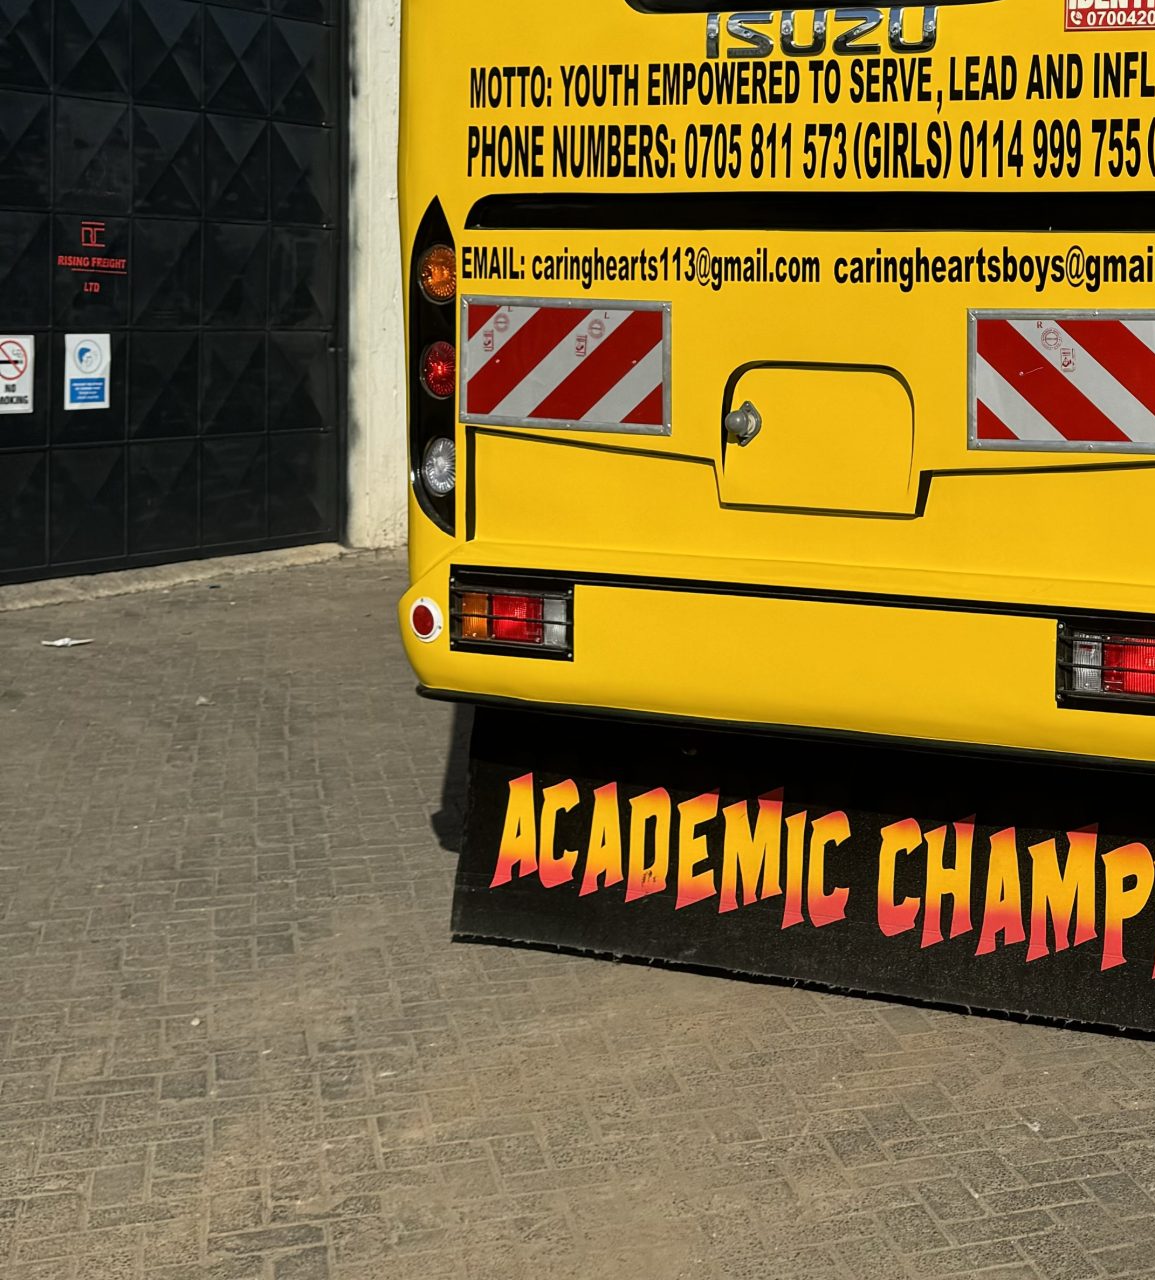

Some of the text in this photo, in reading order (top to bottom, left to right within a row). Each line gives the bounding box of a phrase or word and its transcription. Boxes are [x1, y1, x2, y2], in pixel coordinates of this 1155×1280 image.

[705, 7, 938, 60] ISUZU
[470, 66, 552, 109] MOTTO:
[559, 64, 639, 108] YOUTH
[647, 60, 800, 106] EMPOWERED
[808, 59, 841, 104] TO
[1025, 53, 1084, 100] AND
[467, 125, 544, 178] PHONE
[552, 123, 676, 179] NUMBERS:
[684, 123, 742, 179] 0705
[750, 122, 792, 179] 811
[959, 119, 1024, 179] 0114
[1032, 118, 1082, 179] 999
[57, 255, 127, 269] RISING FREIGHT
[83, 282, 100, 293] LTD
[461, 246, 525, 280] EMAIL:
[531, 246, 820, 292] caringhearts113@gmail.com
[490, 772, 851, 929] ACADEMIC
